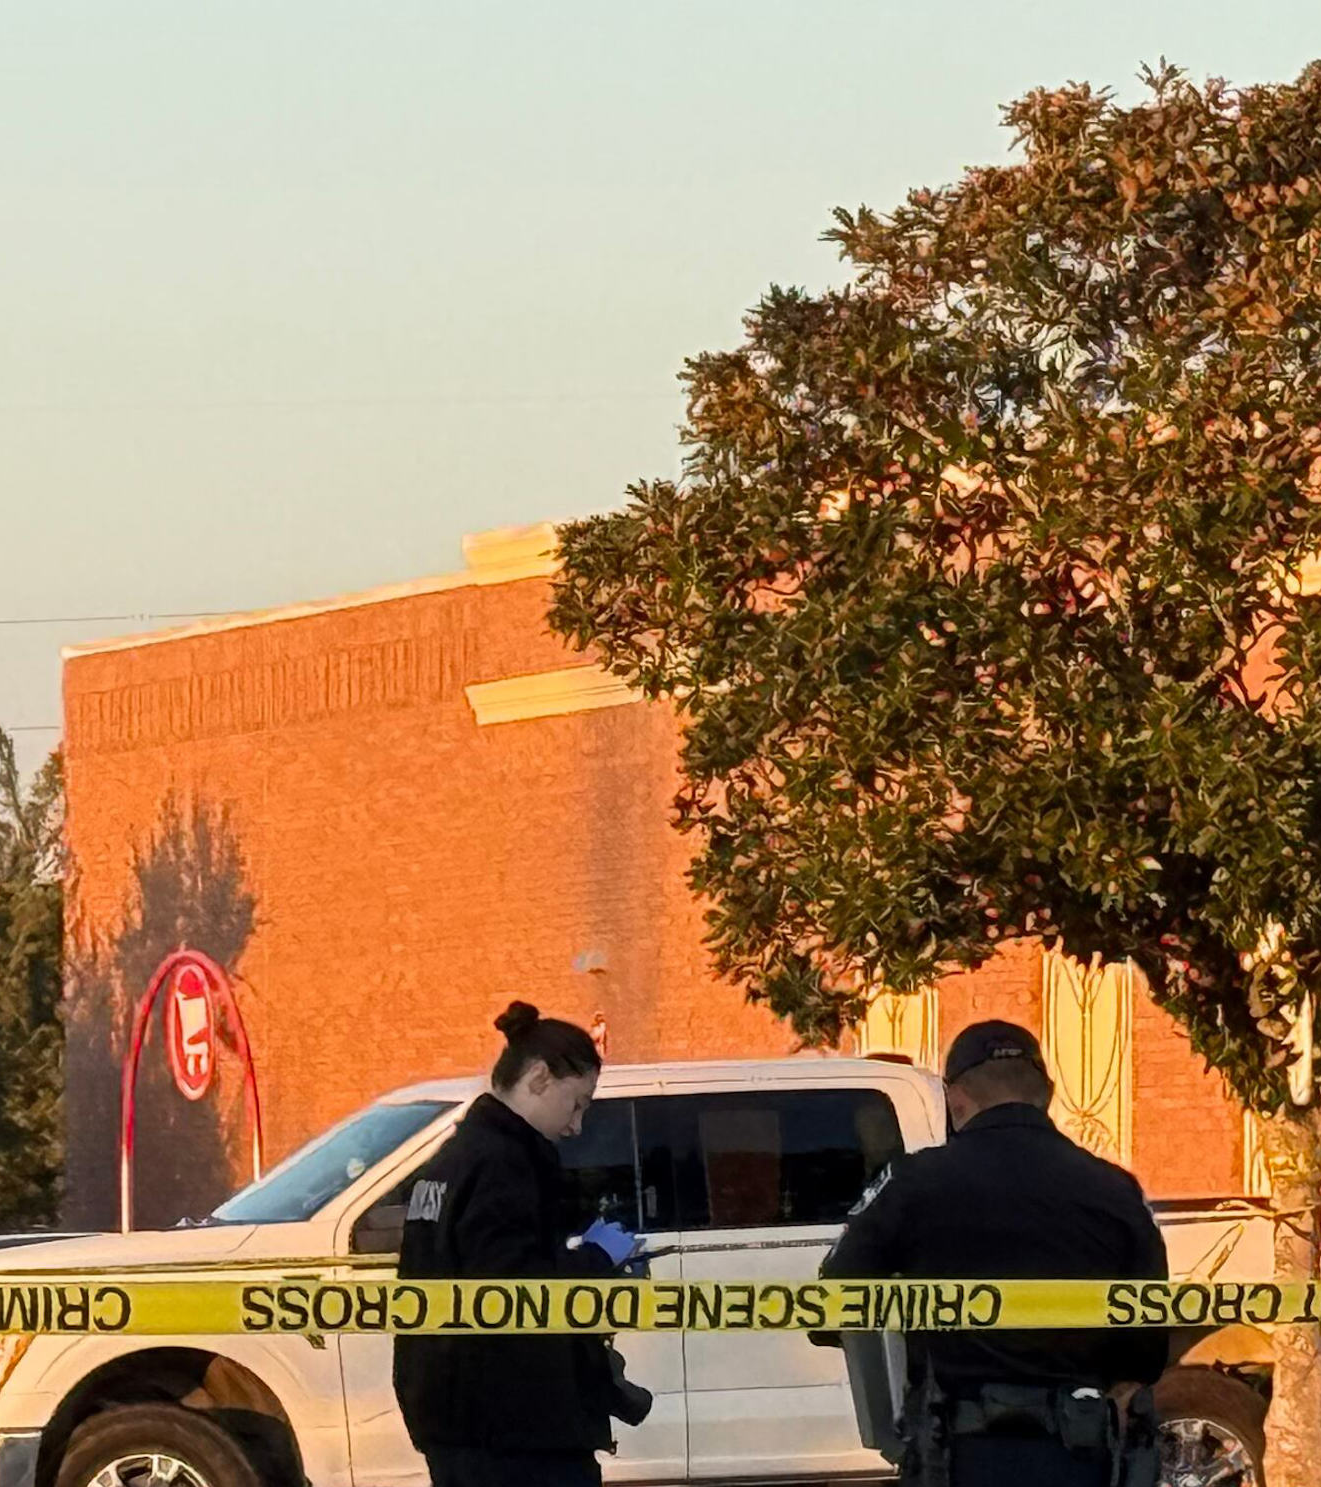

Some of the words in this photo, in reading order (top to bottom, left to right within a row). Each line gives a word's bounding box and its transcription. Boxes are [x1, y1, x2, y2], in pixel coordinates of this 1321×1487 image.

[241, 1285, 428, 1332] CROSS
[438, 1284, 549, 1330] NOT
[564, 1285, 639, 1329] DO
[653, 1285, 830, 1330] SCENE
[839, 1284, 1002, 1329] CRIME
[1106, 1283, 1282, 1325] CROSS
